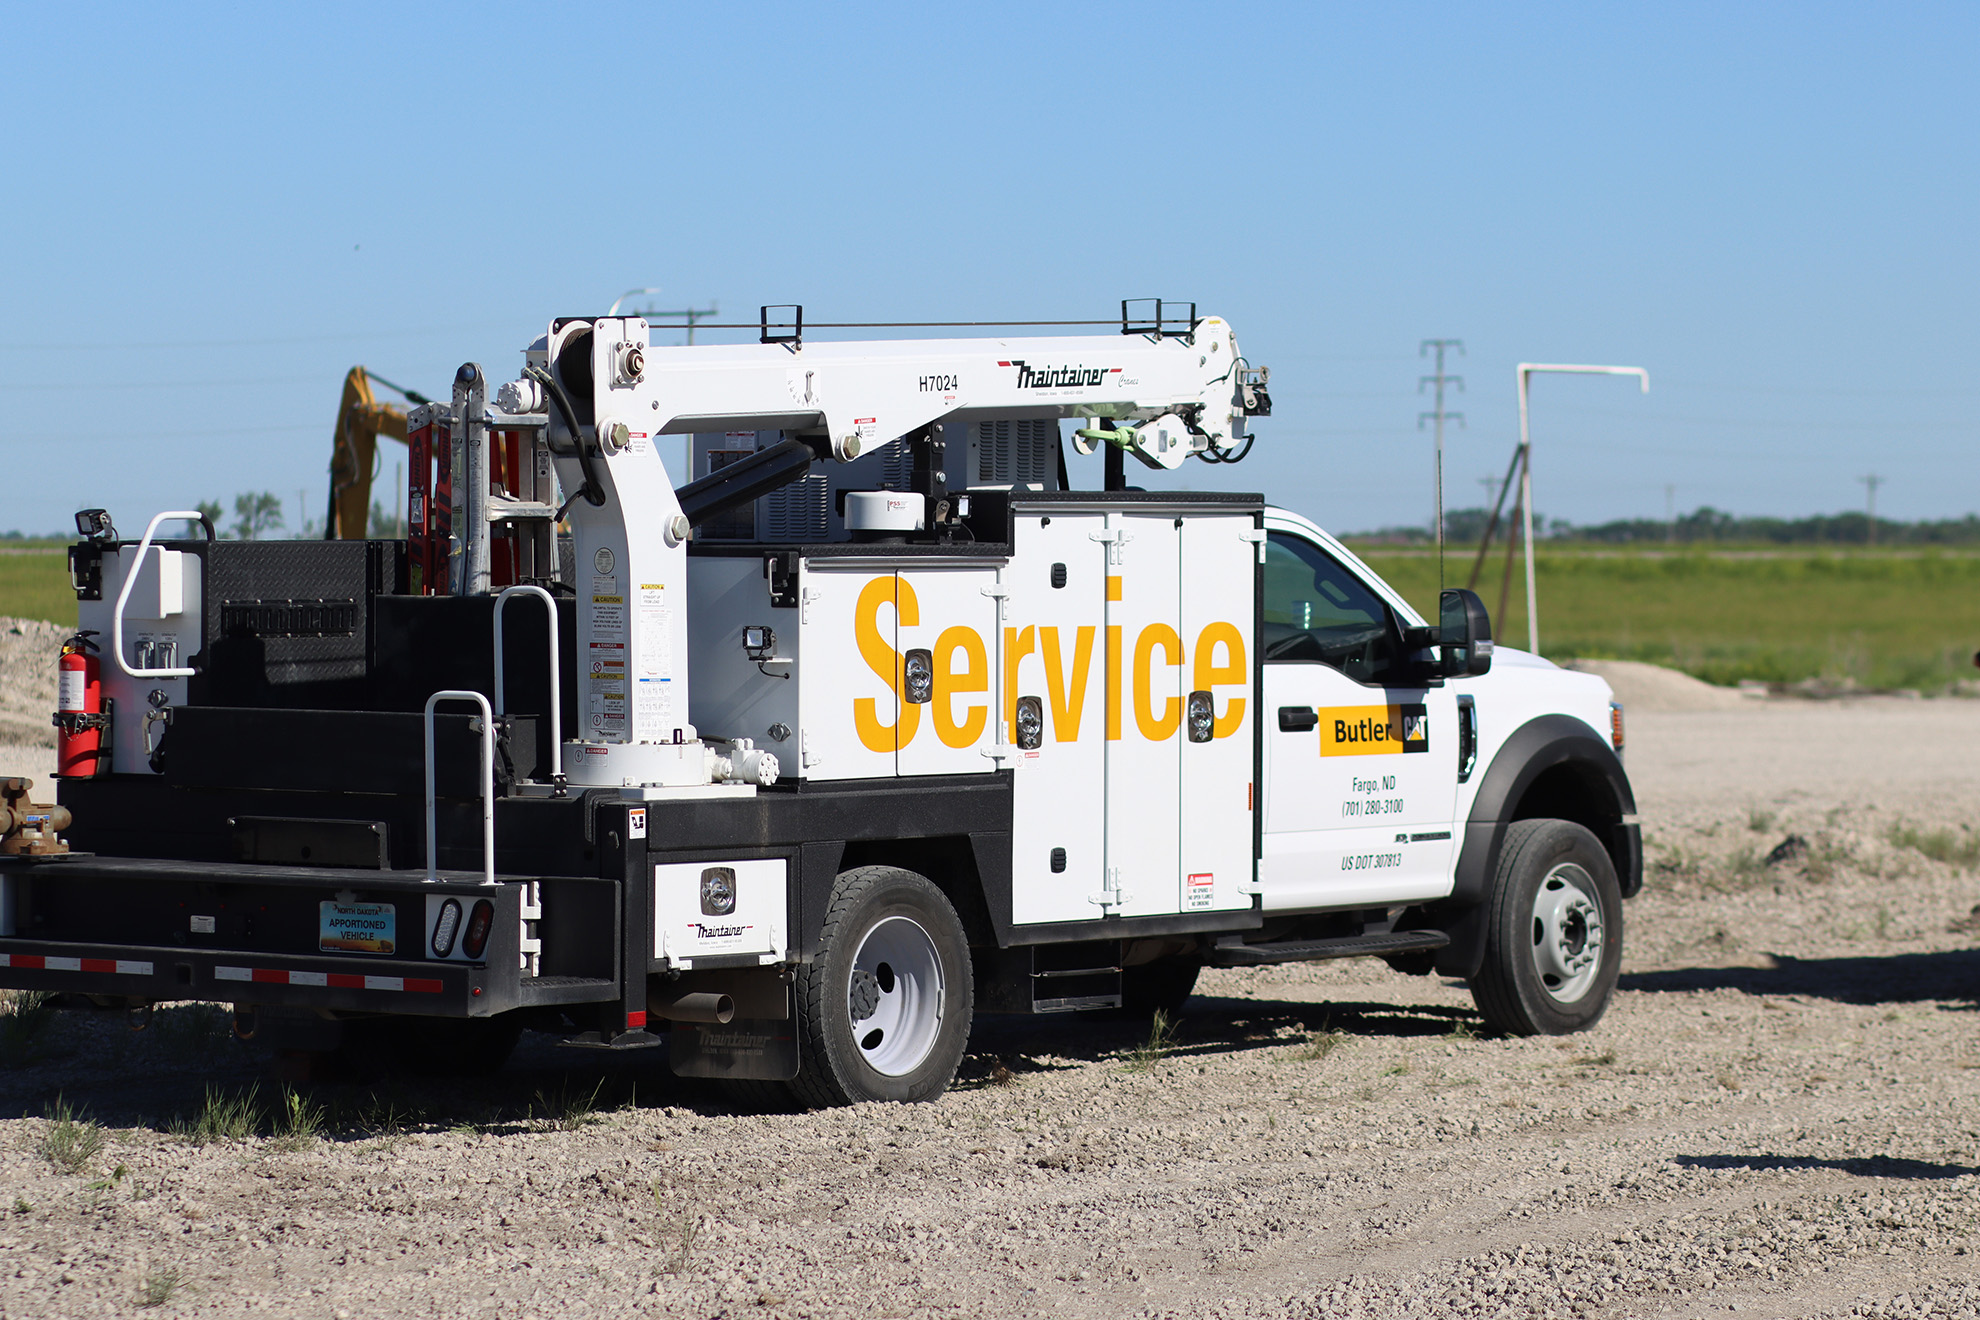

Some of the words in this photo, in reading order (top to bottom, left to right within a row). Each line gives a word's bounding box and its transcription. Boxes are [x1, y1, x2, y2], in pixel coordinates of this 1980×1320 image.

[919, 374, 958, 392] H7024
[1011, 360, 1110, 389] Maintainer
[853, 575, 1247, 753] Service
[1335, 717, 1392, 743] Butler
[1404, 715, 1427, 741] CAT
[1352, 777, 1380, 795] Fargo,
[1382, 775, 1396, 790] ND
[1342, 800, 1363, 818] (701)
[1365, 798, 1404, 815] 280-3100
[1341, 855, 1354, 871] US
[1355, 854, 1374, 870] DOT
[1374, 853, 1402, 869] 307813
[357, 908, 379, 916] DAKOTA
[329, 918, 386, 929] APPORTIONED
[695, 923, 746, 938] Maintainer
[340, 931, 375, 941] VEHICLE
[695, 1026, 771, 1048] Maintainer
